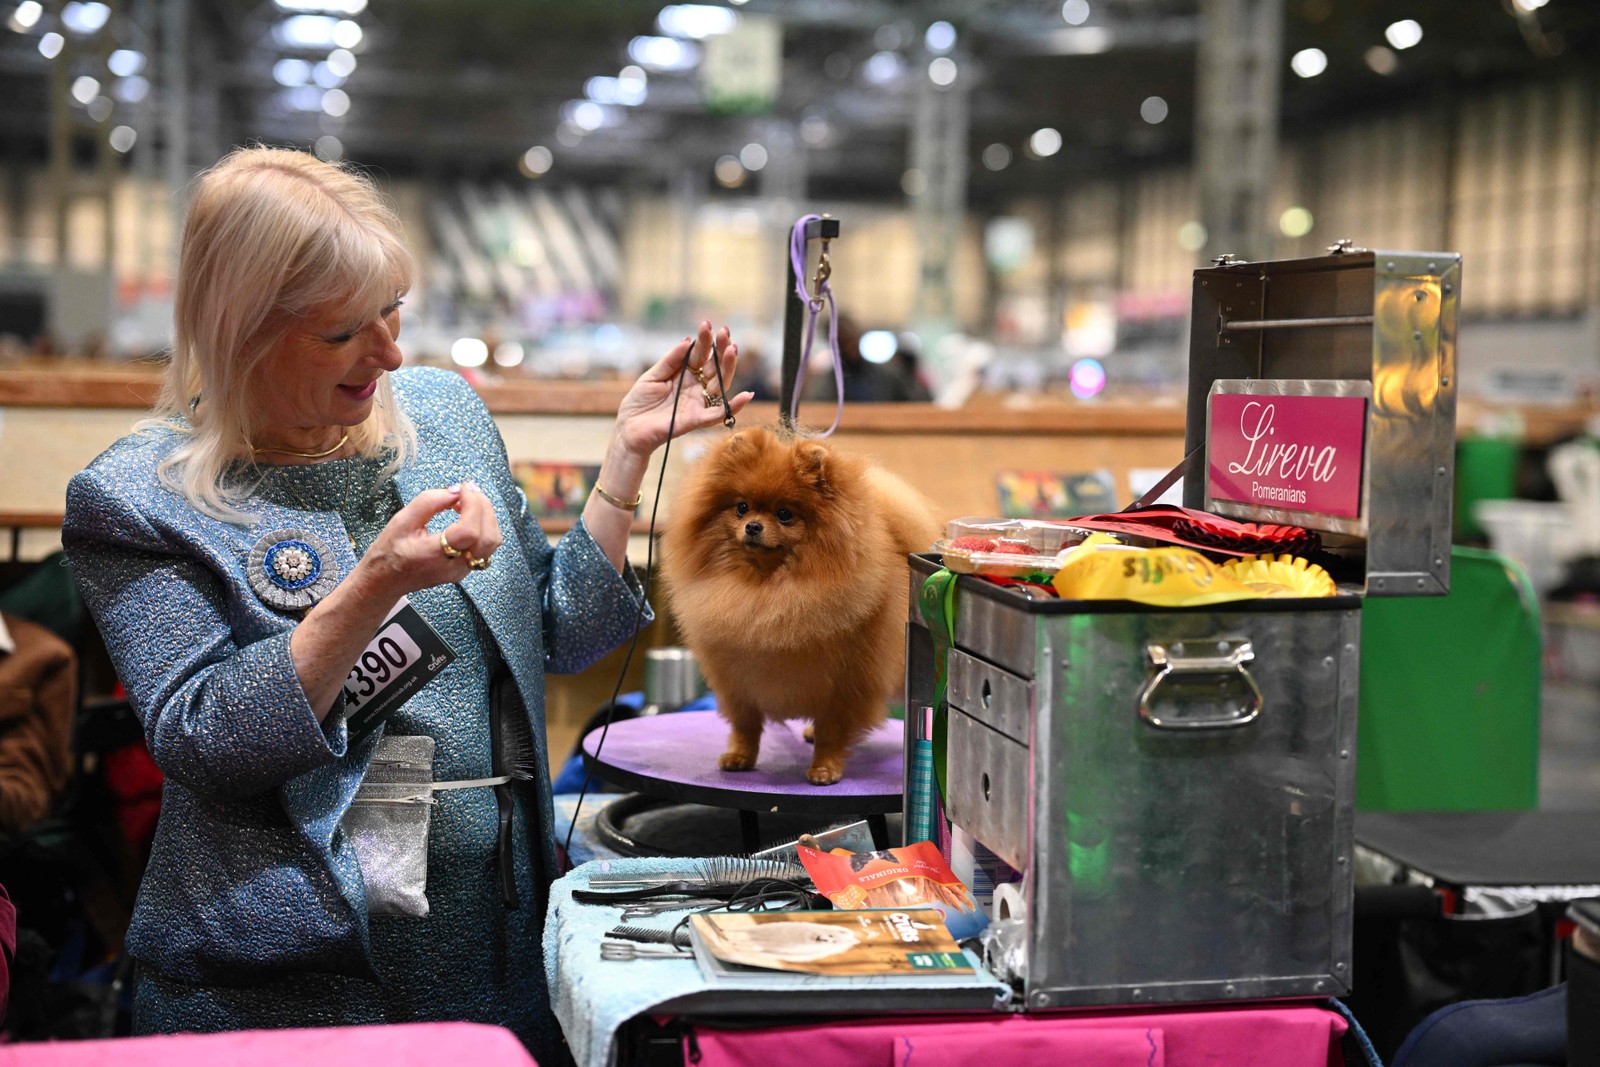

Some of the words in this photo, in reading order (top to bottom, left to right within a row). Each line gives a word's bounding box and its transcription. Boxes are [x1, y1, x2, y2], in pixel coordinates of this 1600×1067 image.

[1228, 402, 1337, 483] Lireva
[1252, 481, 1306, 503] Pomeranians
[859, 867, 909, 883] ORIGINALS
